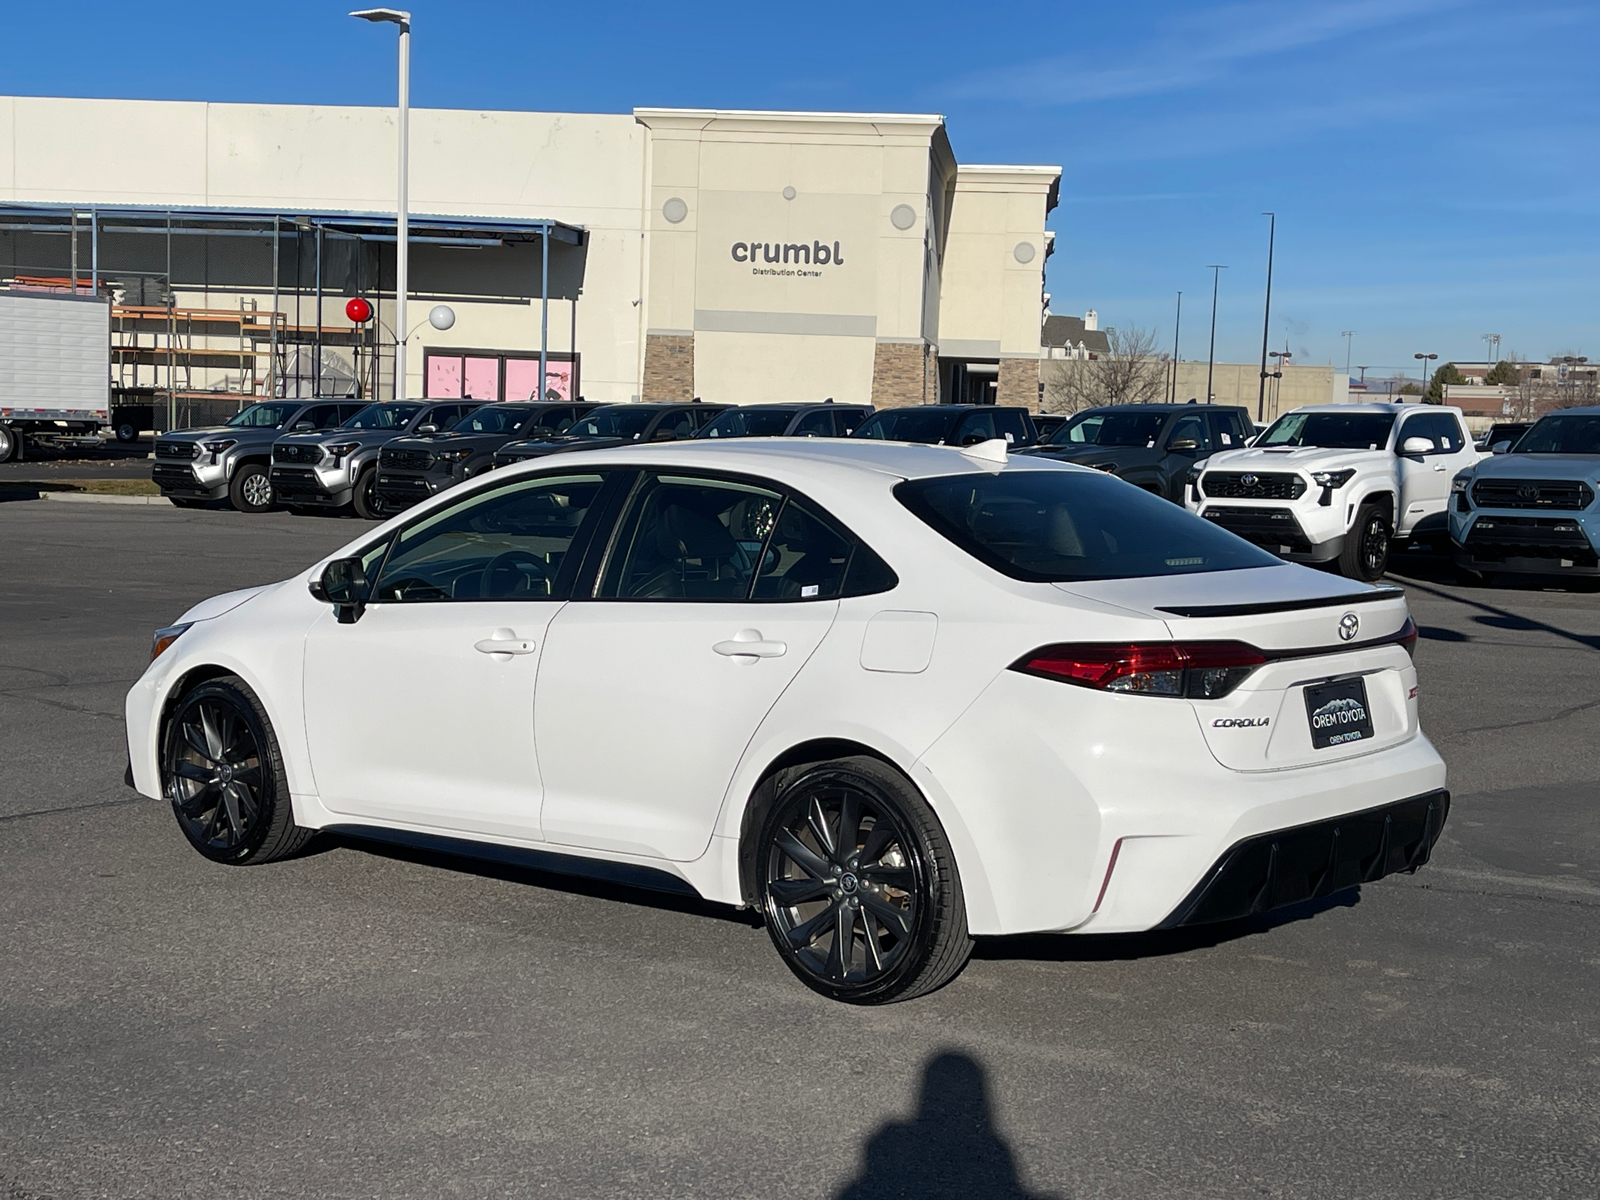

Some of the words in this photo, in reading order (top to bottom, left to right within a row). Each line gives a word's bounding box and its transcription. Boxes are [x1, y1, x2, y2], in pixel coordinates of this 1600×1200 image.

[731, 240, 844, 266] crumbl
[752, 268, 795, 277] Distribution
[796, 269, 823, 277] Center
[1212, 717, 1270, 728] COROLLA
[1312, 713, 1337, 729] OREM
[1337, 708, 1366, 724] TOYOTA
[1329, 735, 1344, 744] OREM
[1343, 731, 1362, 741] TOYOTA
